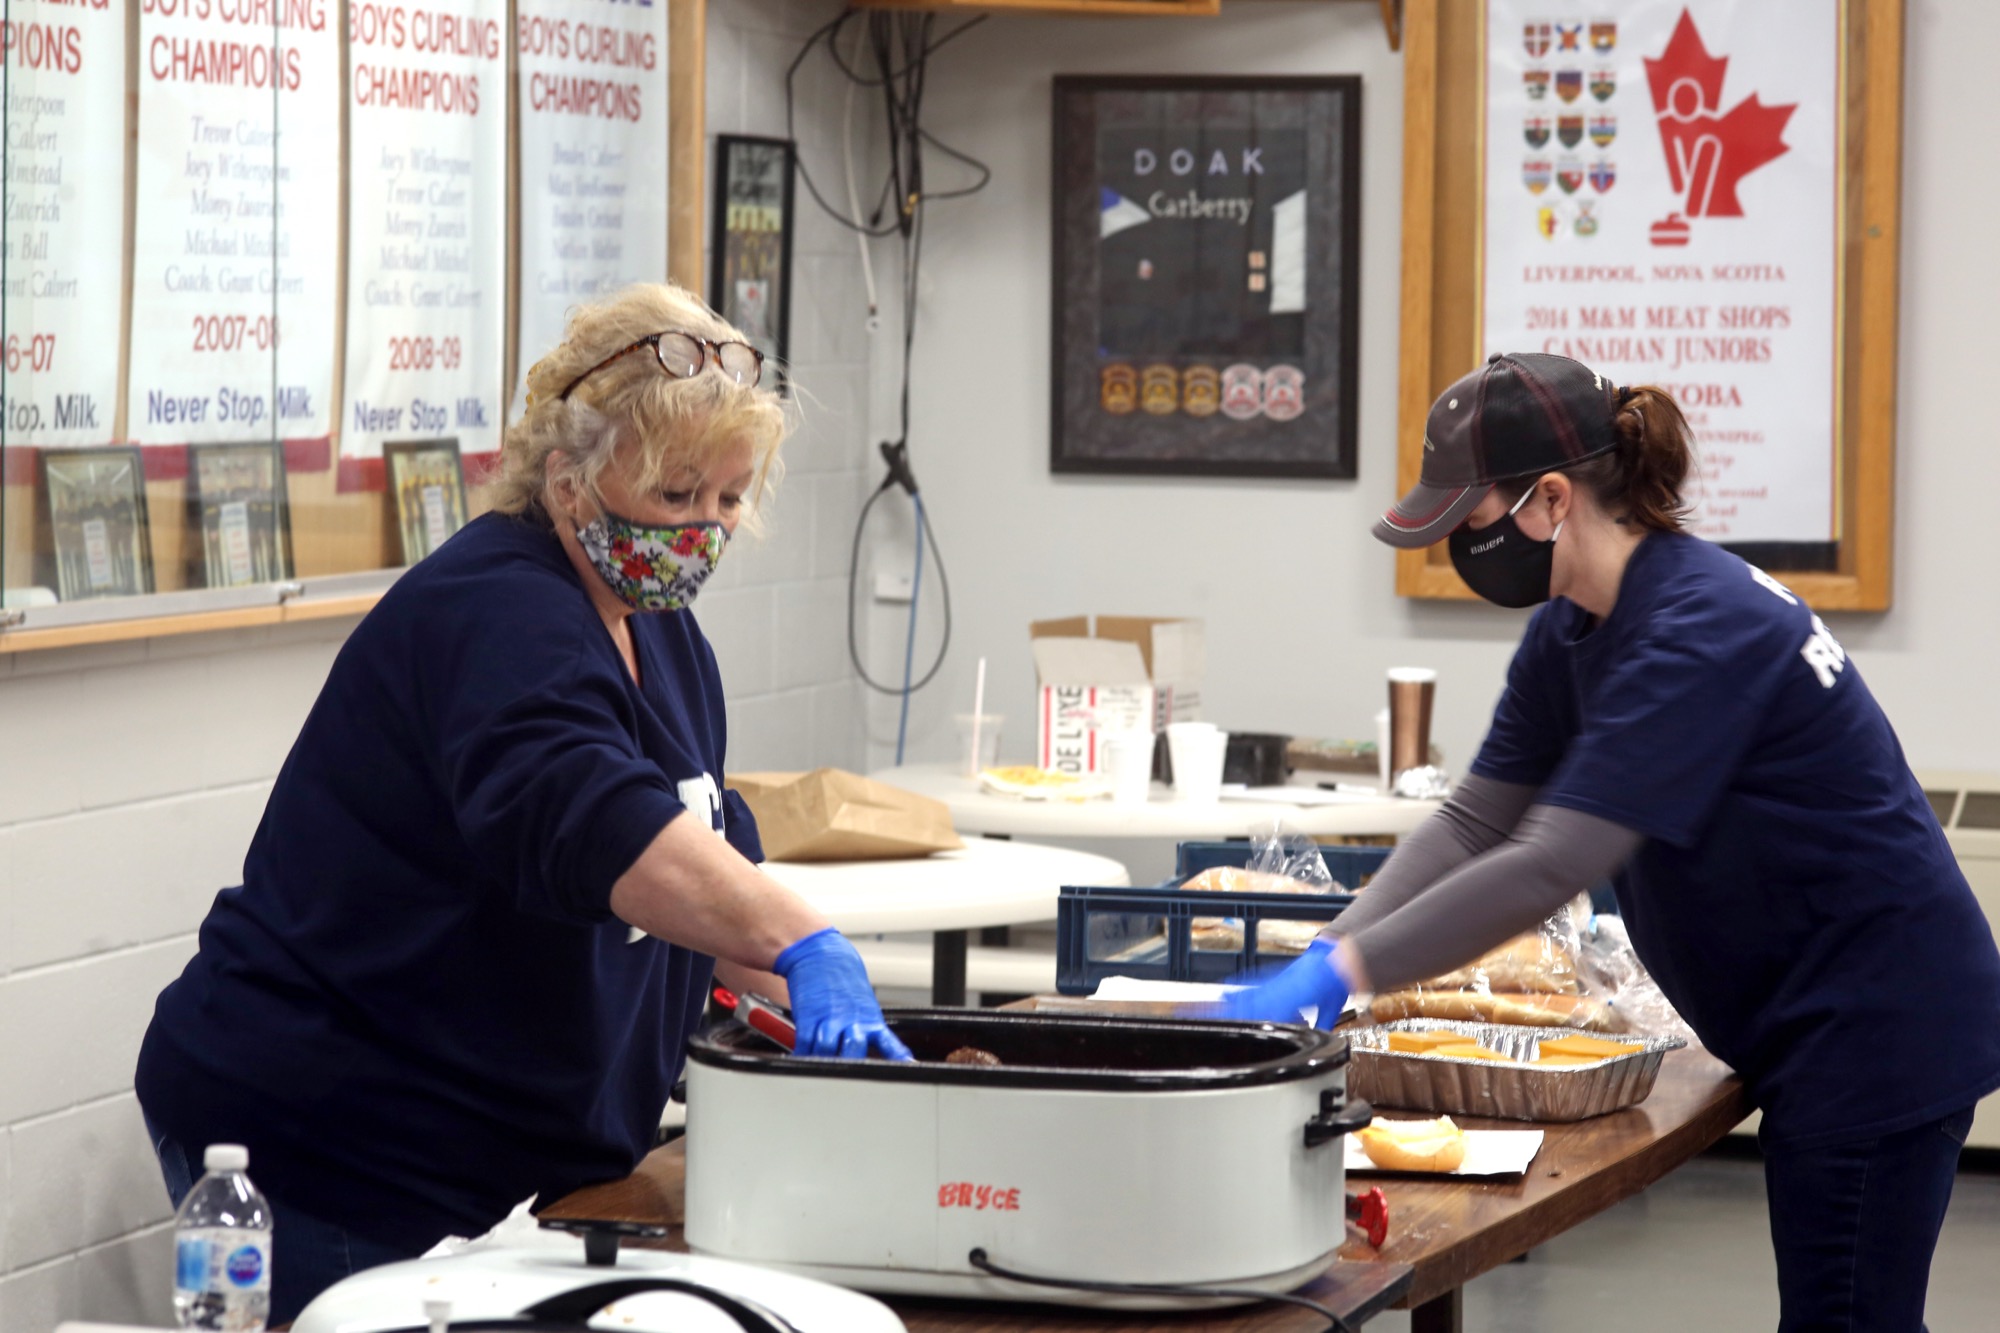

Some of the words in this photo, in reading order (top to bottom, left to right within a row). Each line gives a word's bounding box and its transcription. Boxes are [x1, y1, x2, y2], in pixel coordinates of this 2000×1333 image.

[350, 3, 405, 48] BOYS
[411, 9, 498, 60] CURLING
[518, 15, 571, 59] BOYS
[575, 22, 656, 71] CURLING
[150, 34, 301, 92] CHAMPIONS
[354, 63, 480, 117] CHAMPIONS
[529, 72, 642, 122] CHAMPIONS
[1147, 189, 1254, 226] Carberry
[1522, 265, 1644, 284] LIVERPOOL,
[1651, 265, 1705, 282] NOVA
[1711, 264, 1787, 282] SCOTIA
[1578, 305, 1637, 330] M&M
[1645, 305, 1711, 330] MEAT
[1717, 305, 1792, 330] SHOPS
[388, 335, 462, 371] 2008-09
[1542, 336, 1665, 363] CANADIAN
[1672, 336, 1773, 369] JUNIORS
[54, 394, 99, 431] Milk.
[148, 388, 208, 424] Never
[354, 400, 404, 433] Never
[937, 1181, 1021, 1211] BRYCE
